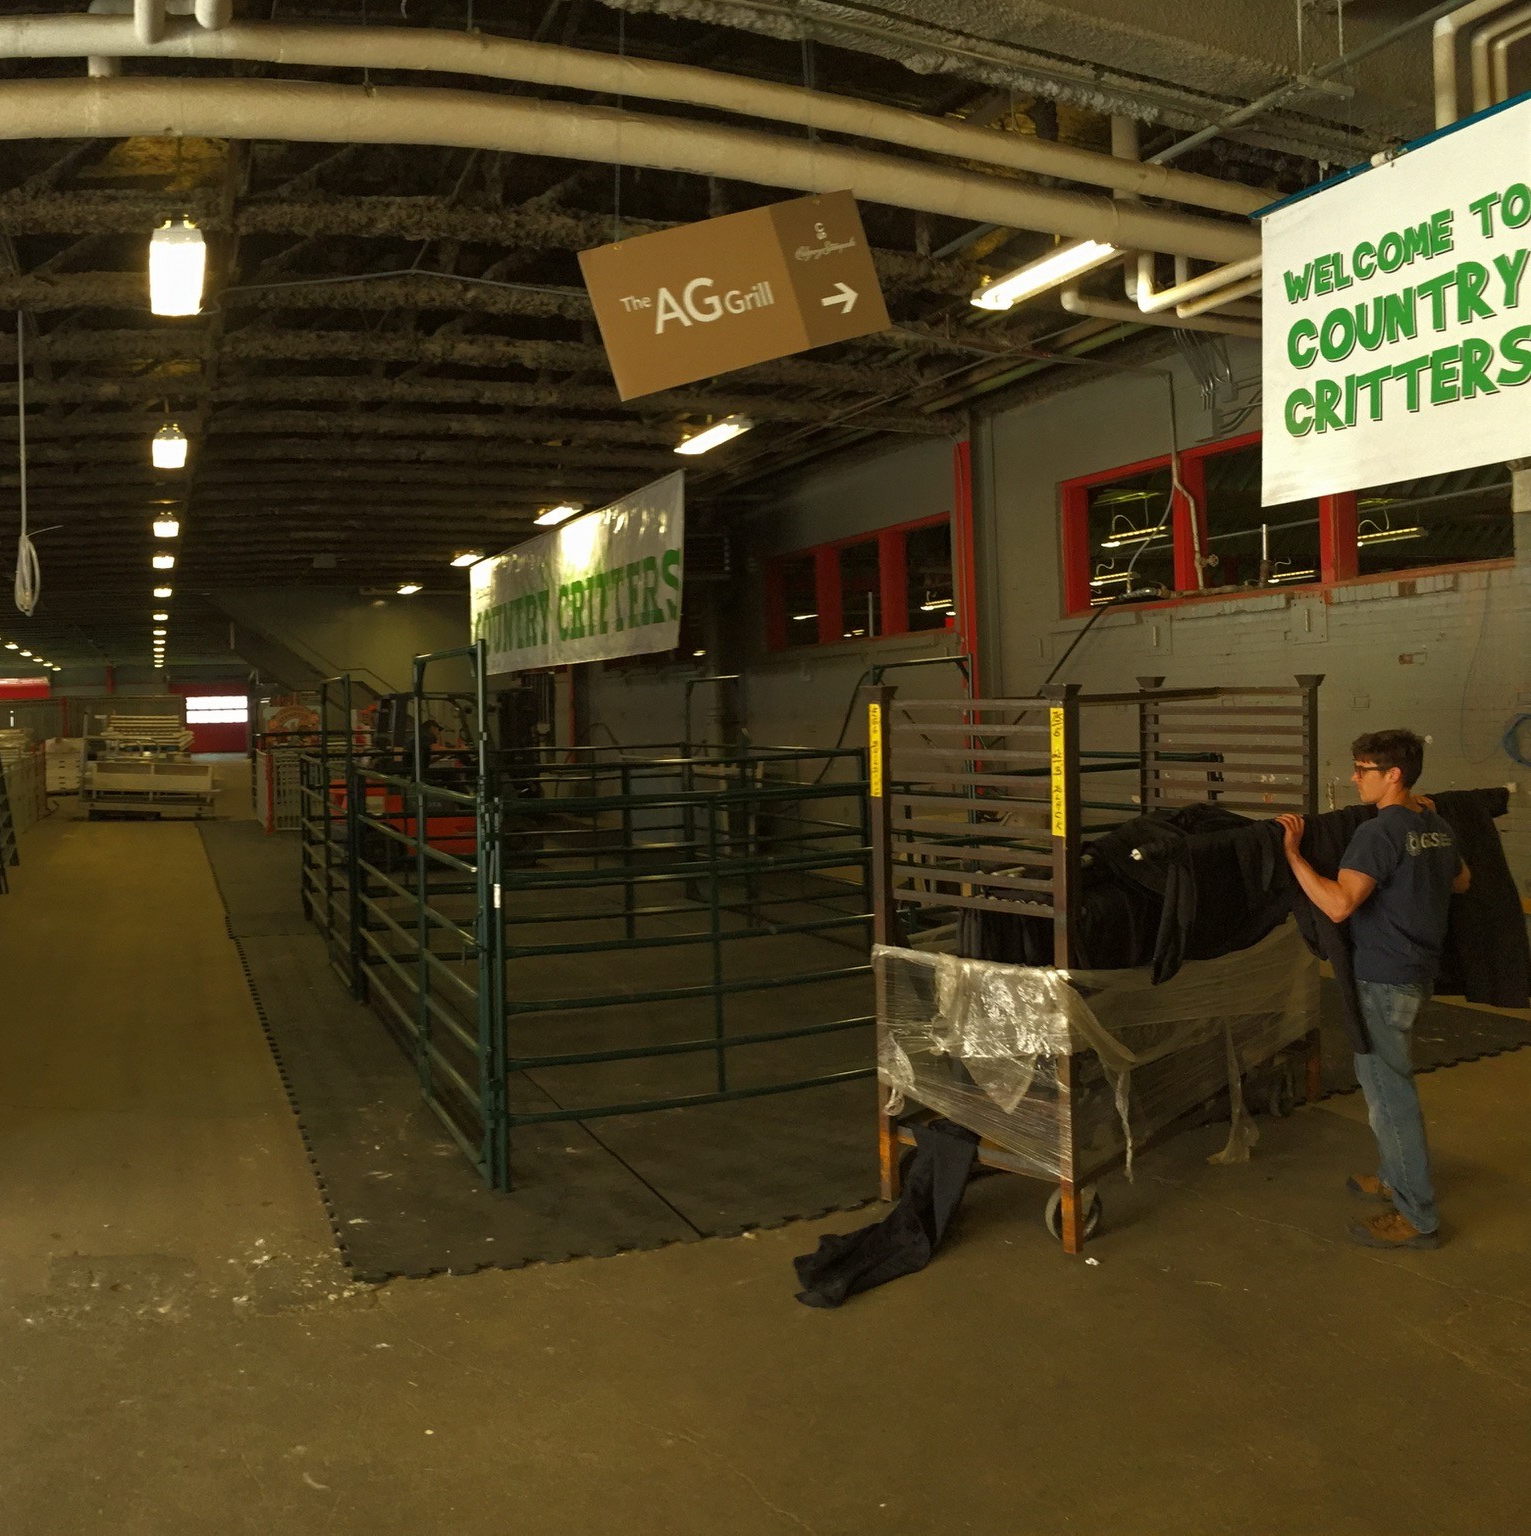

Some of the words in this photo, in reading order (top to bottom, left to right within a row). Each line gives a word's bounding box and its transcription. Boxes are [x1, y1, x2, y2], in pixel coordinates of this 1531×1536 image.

[1284, 209, 1454, 305] WELCOME
[1469, 183, 1531, 238] TO
[620, 295, 652, 313] The
[656, 277, 724, 335] AG
[724, 281, 774, 315] Grill
[1287, 249, 1528, 370] COUNTRY
[1284, 325, 1531, 437] CRITTERS
[558, 548, 680, 641] CRITTERS
